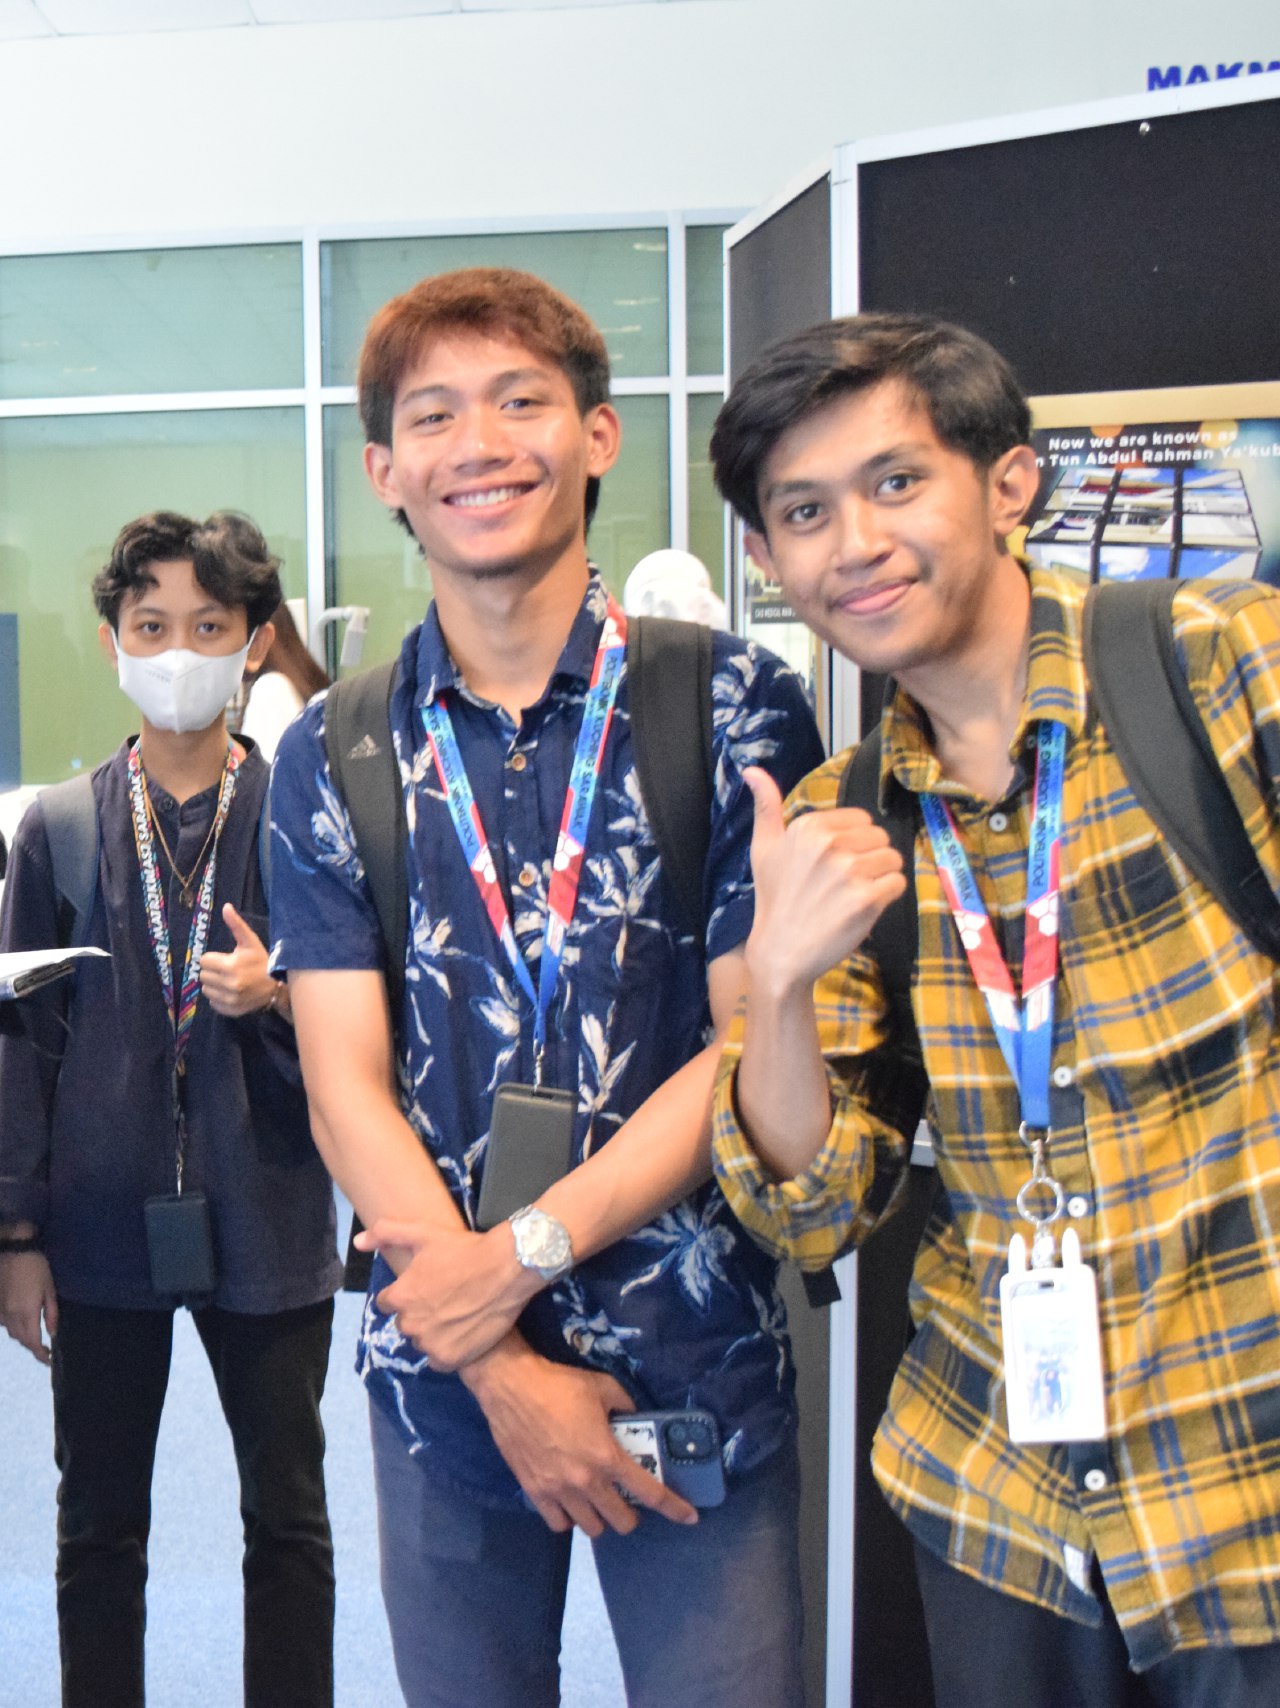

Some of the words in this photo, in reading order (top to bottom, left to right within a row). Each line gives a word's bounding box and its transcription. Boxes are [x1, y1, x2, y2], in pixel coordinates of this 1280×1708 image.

[1049, 437, 1085, 451] Now
[1090, 436, 1114, 449] we
[1119, 434, 1147, 447] are
[1152, 430, 1212, 445] known
[1217, 430, 1238, 442] as
[1050, 453, 1080, 467] Tun
[1085, 449, 1137, 466] Abdul
[1142, 446, 1214, 463] Rahman
[131, 774, 149, 842] SARAWAK
